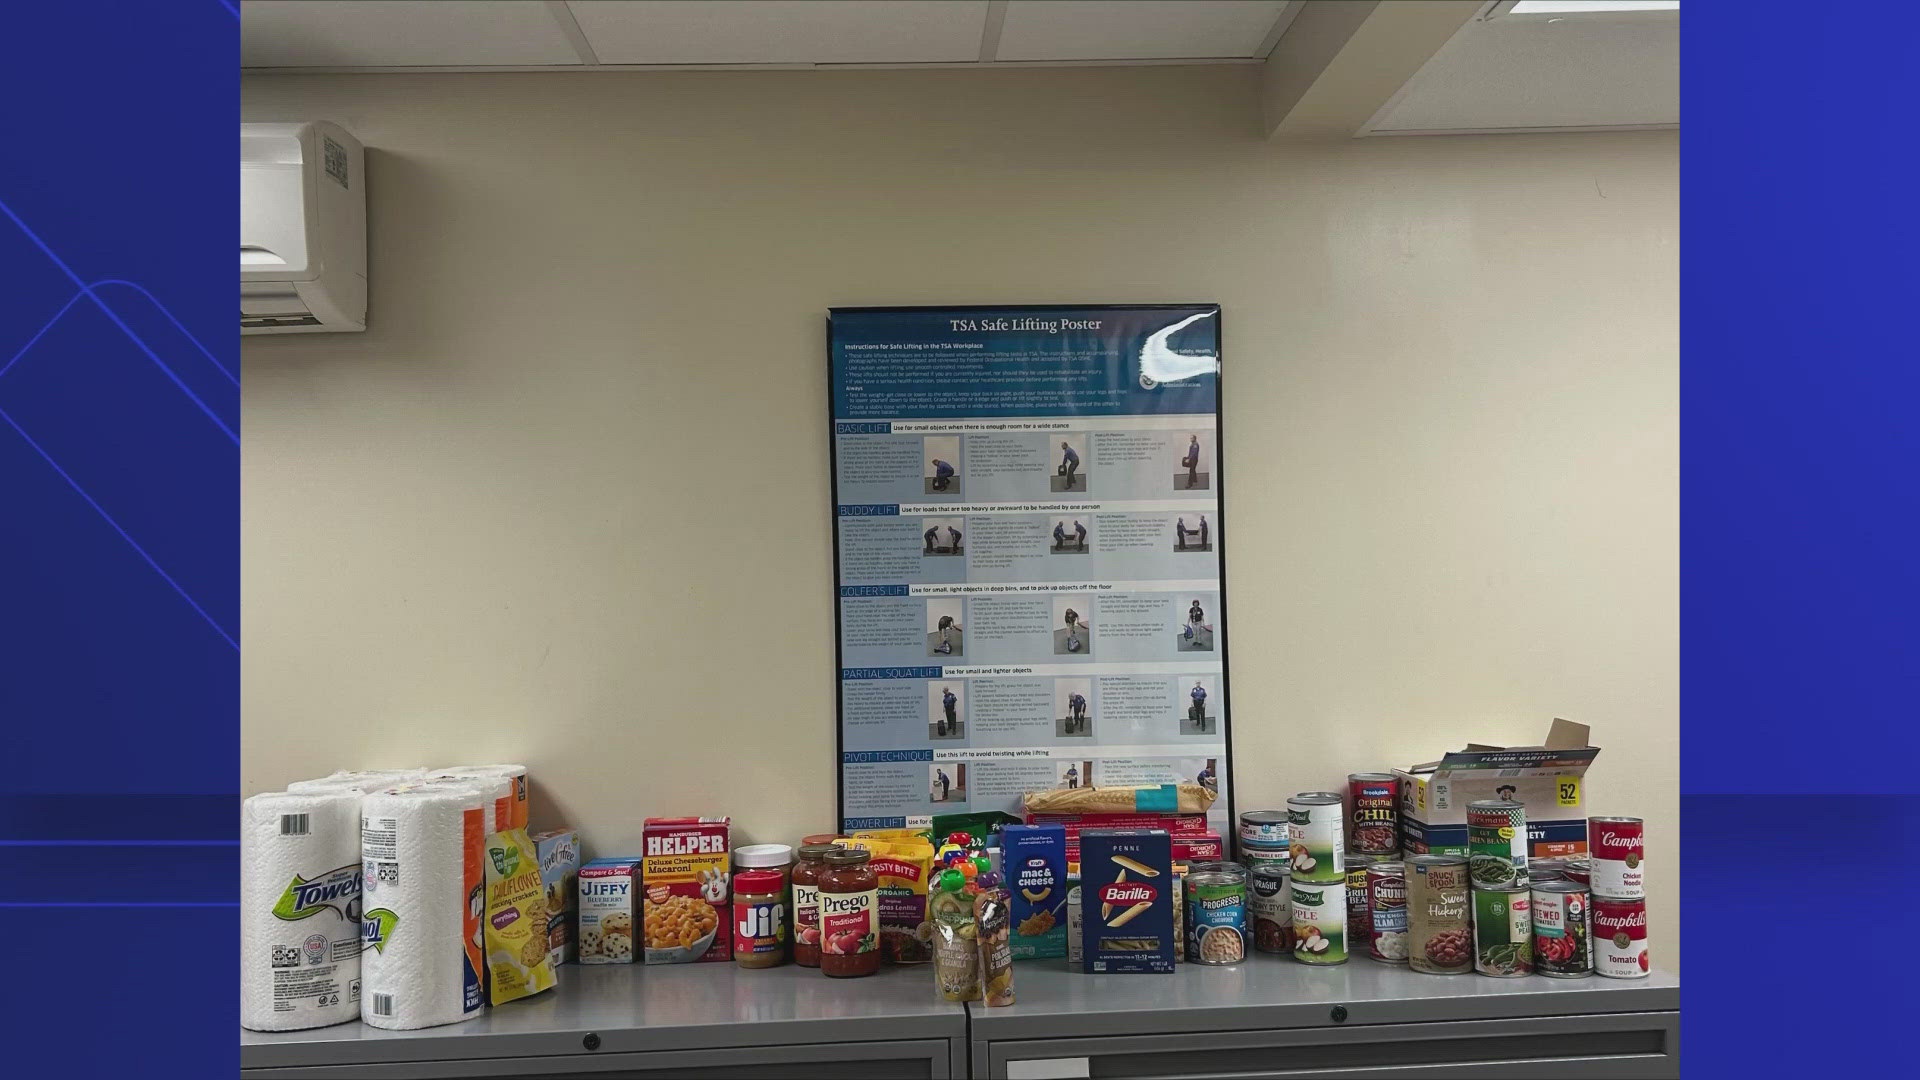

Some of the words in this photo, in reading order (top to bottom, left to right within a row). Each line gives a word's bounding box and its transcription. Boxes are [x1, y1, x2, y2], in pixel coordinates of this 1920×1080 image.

[950, 319, 977, 331] TSA
[981, 318, 1008, 330] Safe
[1012, 317, 1056, 333] Lifting
[1060, 318, 1101, 329] Poster
[903, 343, 922, 351] Lifting
[952, 343, 982, 351] Workplace
[838, 423, 865, 434] BASIC
[867, 422, 888, 433] LIFT
[840, 506, 874, 515] BUDDY
[877, 505, 897, 514] LIFT
[888, 585, 908, 594] LIFT
[843, 668, 883, 678] PARTIAL
[886, 667, 917, 678] SQUAT
[920, 666, 940, 676] LIFT
[844, 752, 873, 762] PIVOT
[875, 750, 931, 762] TECHNIQUE
[1480, 755, 1518, 763] FLAVOR
[1519, 754, 1559, 762] VARIETY
[1560, 783, 1576, 800] 52
[1358, 798, 1393, 808] Original
[845, 818, 881, 828] POWER
[883, 818, 904, 827] LIFT
[647, 835, 724, 856] HELPER
[1487, 837, 1509, 845] BEANS
[648, 858, 672, 866] Deluxe
[673, 856, 723, 865] Cheeseburger
[580, 869, 607, 877] Compare
[648, 864, 692, 874] Macaroni
[869, 863, 894, 873] TASTY
[894, 864, 916, 877] BITE
[1021, 869, 1044, 878] mac
[1044, 868, 1052, 877] &
[1428, 870, 1454, 880] SAUCY
[581, 881, 629, 896] JIFFY
[1429, 878, 1455, 888] SPOON
[512, 889, 539, 903] crackers
[1106, 888, 1150, 900] Barilla
[1440, 890, 1468, 905] Sweet
[823, 894, 869, 914] Prego
[1202, 895, 1240, 910] PROGRESSO
[1269, 903, 1286, 912] STYLE
[1428, 904, 1464, 919] Hickory
[739, 903, 784, 938] Jif
[829, 915, 863, 927] Traditional
[1374, 917, 1394, 928] CLAM
[1608, 954, 1637, 964] Tomato
